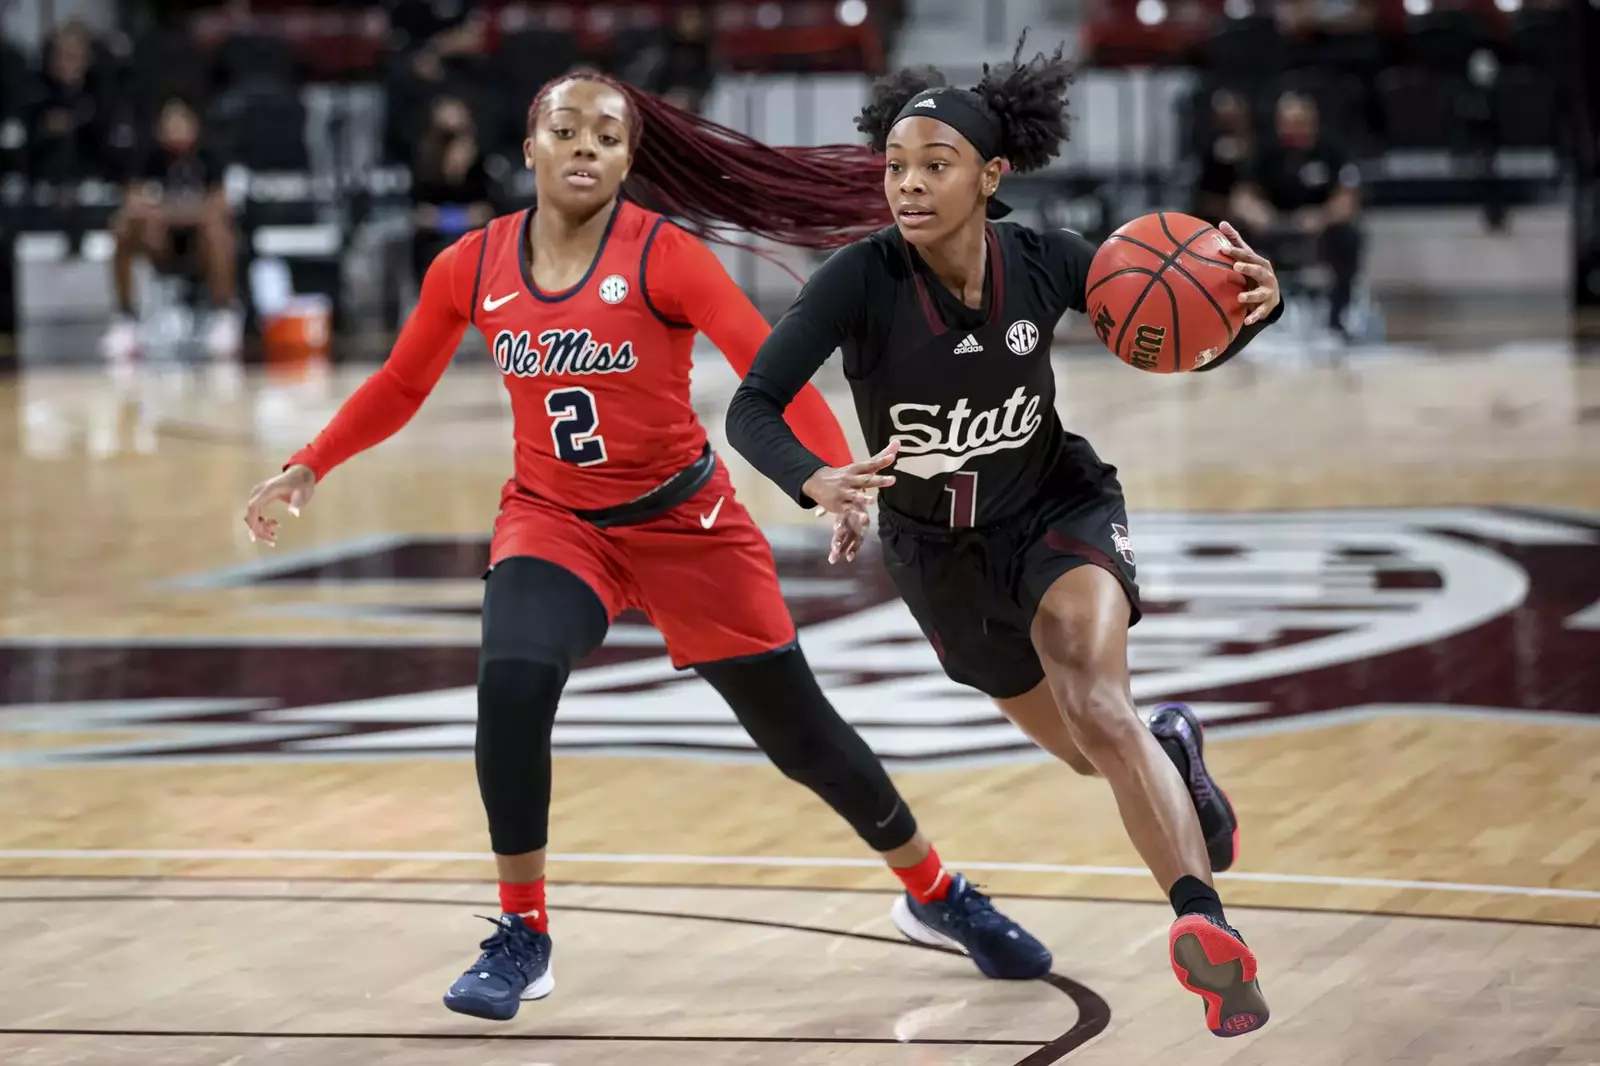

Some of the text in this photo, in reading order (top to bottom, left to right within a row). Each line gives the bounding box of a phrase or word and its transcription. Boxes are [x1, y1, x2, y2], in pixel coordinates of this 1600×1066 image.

[494, 328, 638, 378] Ole Miss
[953, 345, 984, 355] adidas
[1008, 320, 1038, 354] SEC
[544, 386, 608, 467] 2
[889, 386, 1042, 454] State
[944, 471, 978, 528] 1
